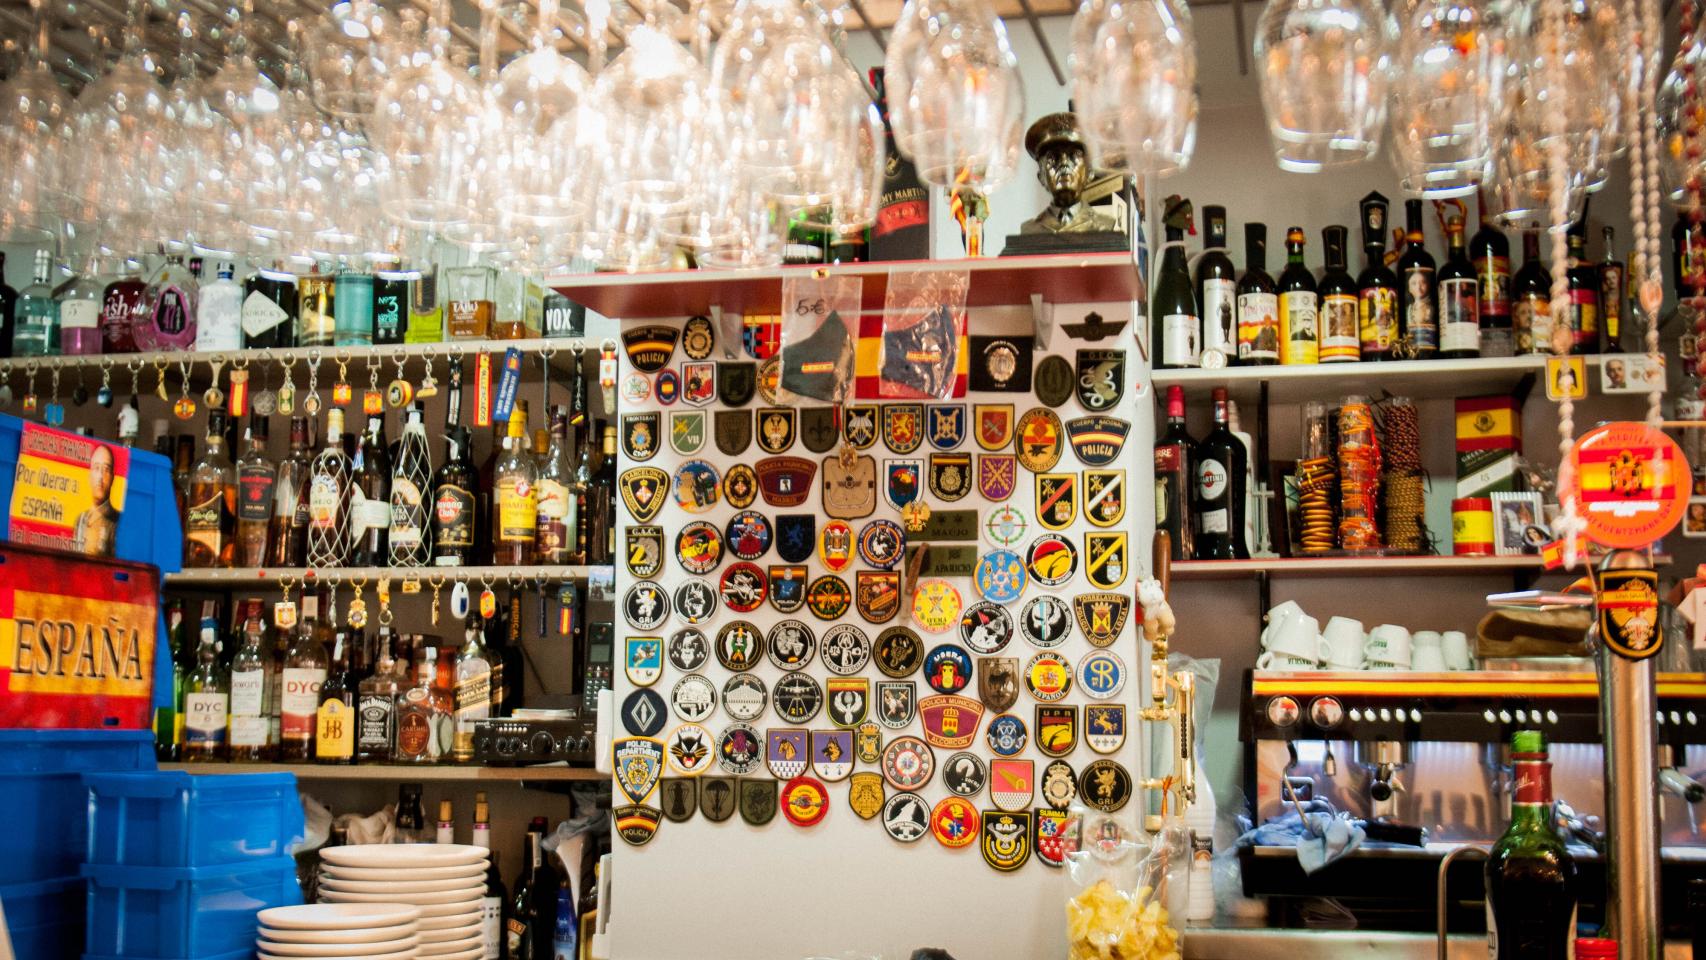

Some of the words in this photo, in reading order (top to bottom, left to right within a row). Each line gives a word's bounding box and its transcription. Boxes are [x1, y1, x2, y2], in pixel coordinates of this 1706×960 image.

[636, 353, 665, 364] POLICIA
[1082, 445, 1113, 456] POLICIA
[16, 463, 36, 485] Por
[38, 469, 70, 492] liberar
[21, 496, 63, 521] ESPAÑA
[11, 616, 143, 680] ESPAÑA
[1033, 688, 1066, 700] ESPAÑOL
[194, 702, 222, 712] DYC
[922, 698, 947, 710] POLICIA
[948, 698, 981, 712] MUNICIPAL
[626, 741, 653, 749] POLICE
[930, 736, 968, 746] ALCORCON
[617, 748, 661, 759] DEPARTMENT
[1040, 809, 1066, 818] SUMMA
[623, 828, 649, 838] POLICIA
